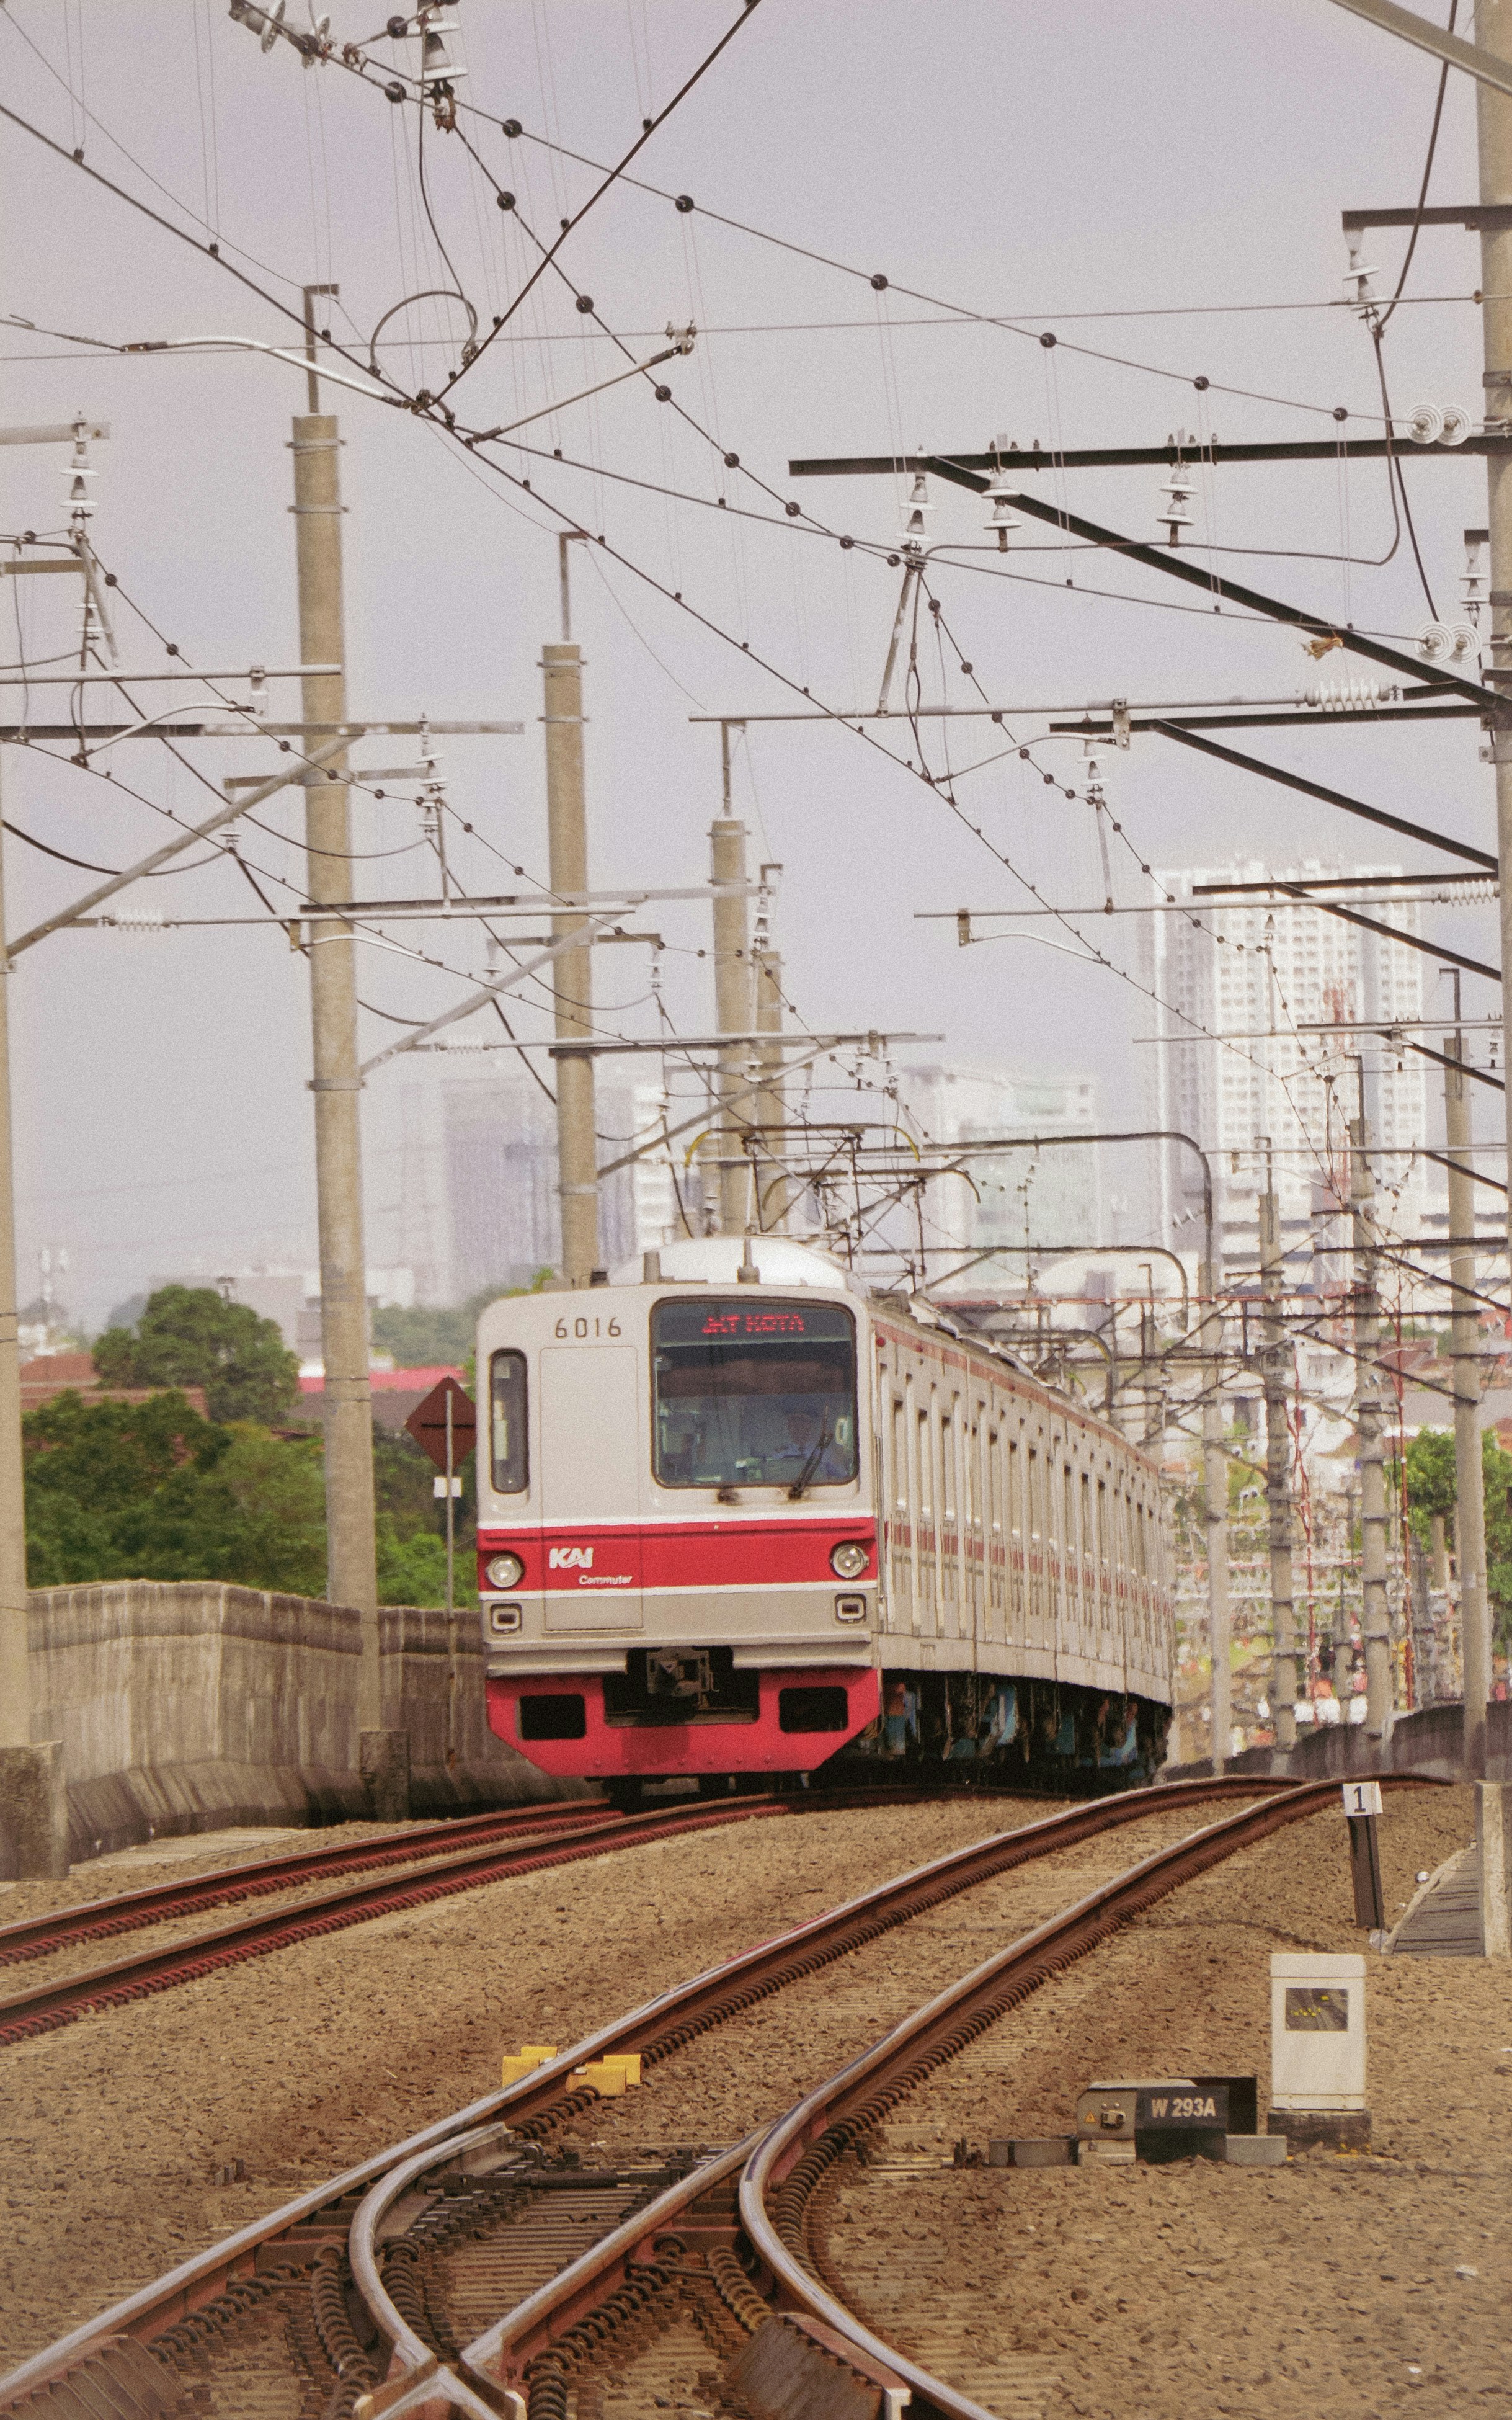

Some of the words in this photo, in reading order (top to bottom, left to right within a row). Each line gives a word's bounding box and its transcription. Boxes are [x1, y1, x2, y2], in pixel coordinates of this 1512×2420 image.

[555, 1317, 621, 1339] 6016
[746, 1313, 804, 1332] KOTA
[549, 1547, 594, 1569] KAI
[579, 1575, 633, 1585] Commuter
[1354, 1786, 1366, 1813] 1
[1151, 2098, 1168, 2118] W
[1172, 2097, 1216, 2117] 293A
